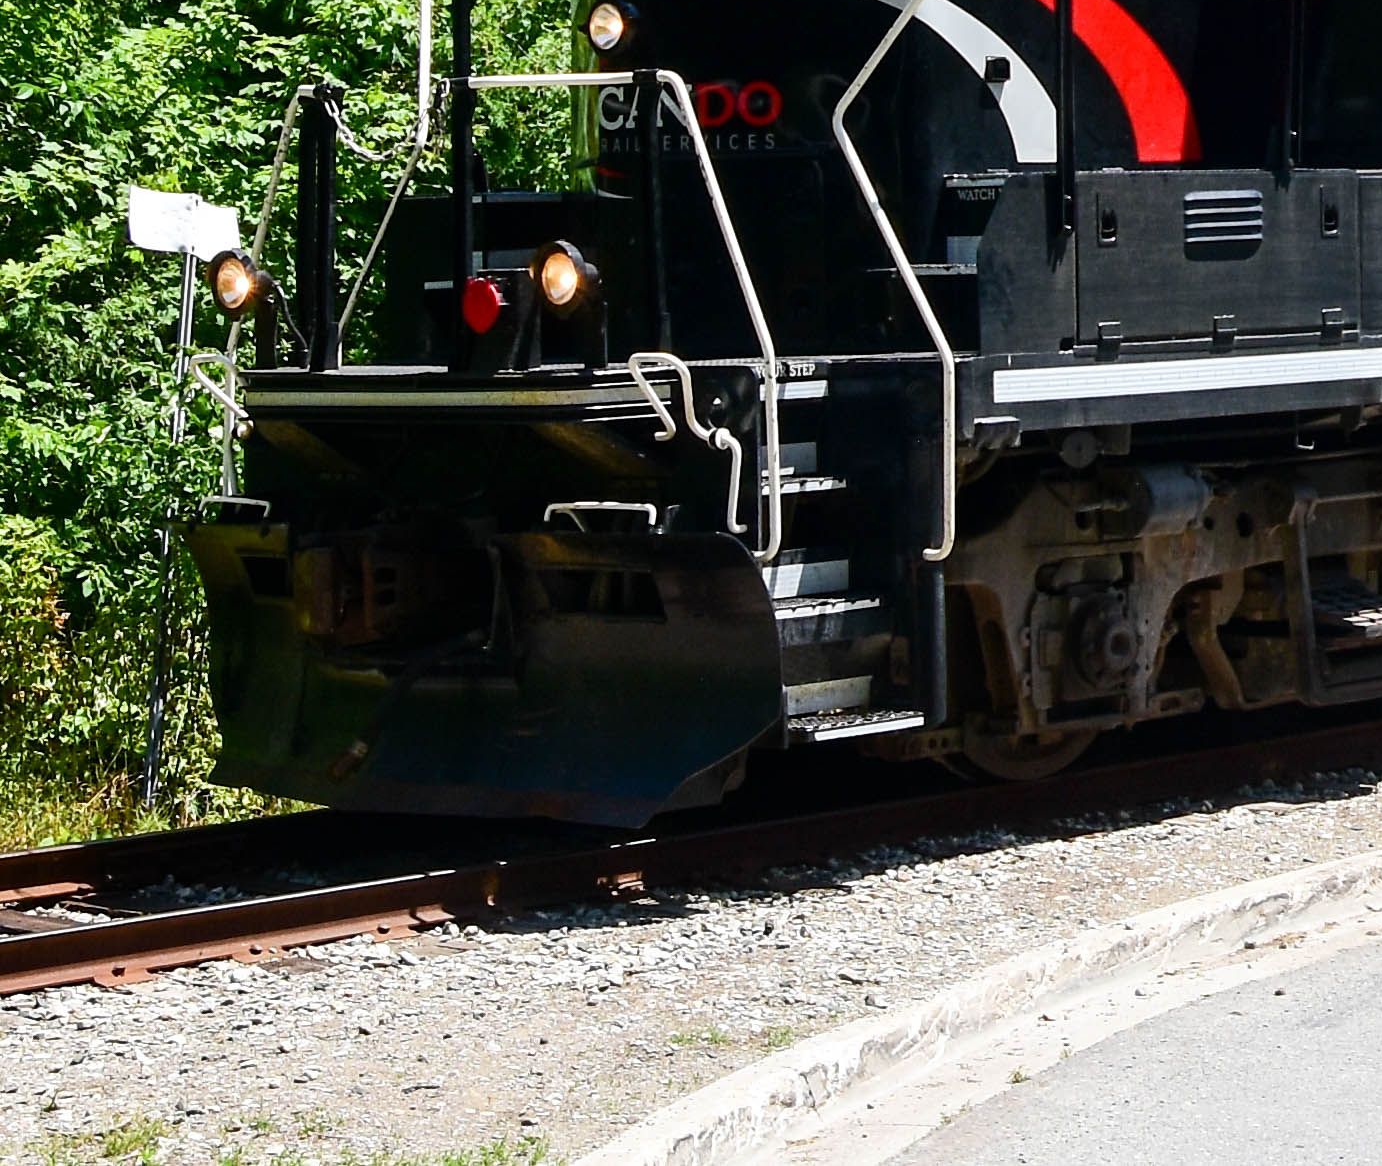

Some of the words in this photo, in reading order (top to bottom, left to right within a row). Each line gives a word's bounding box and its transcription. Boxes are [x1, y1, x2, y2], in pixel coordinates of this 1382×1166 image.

[662, 133, 776, 151] ERICES
[957, 188, 996, 201] WATCH
[789, 363, 816, 377] STEP
